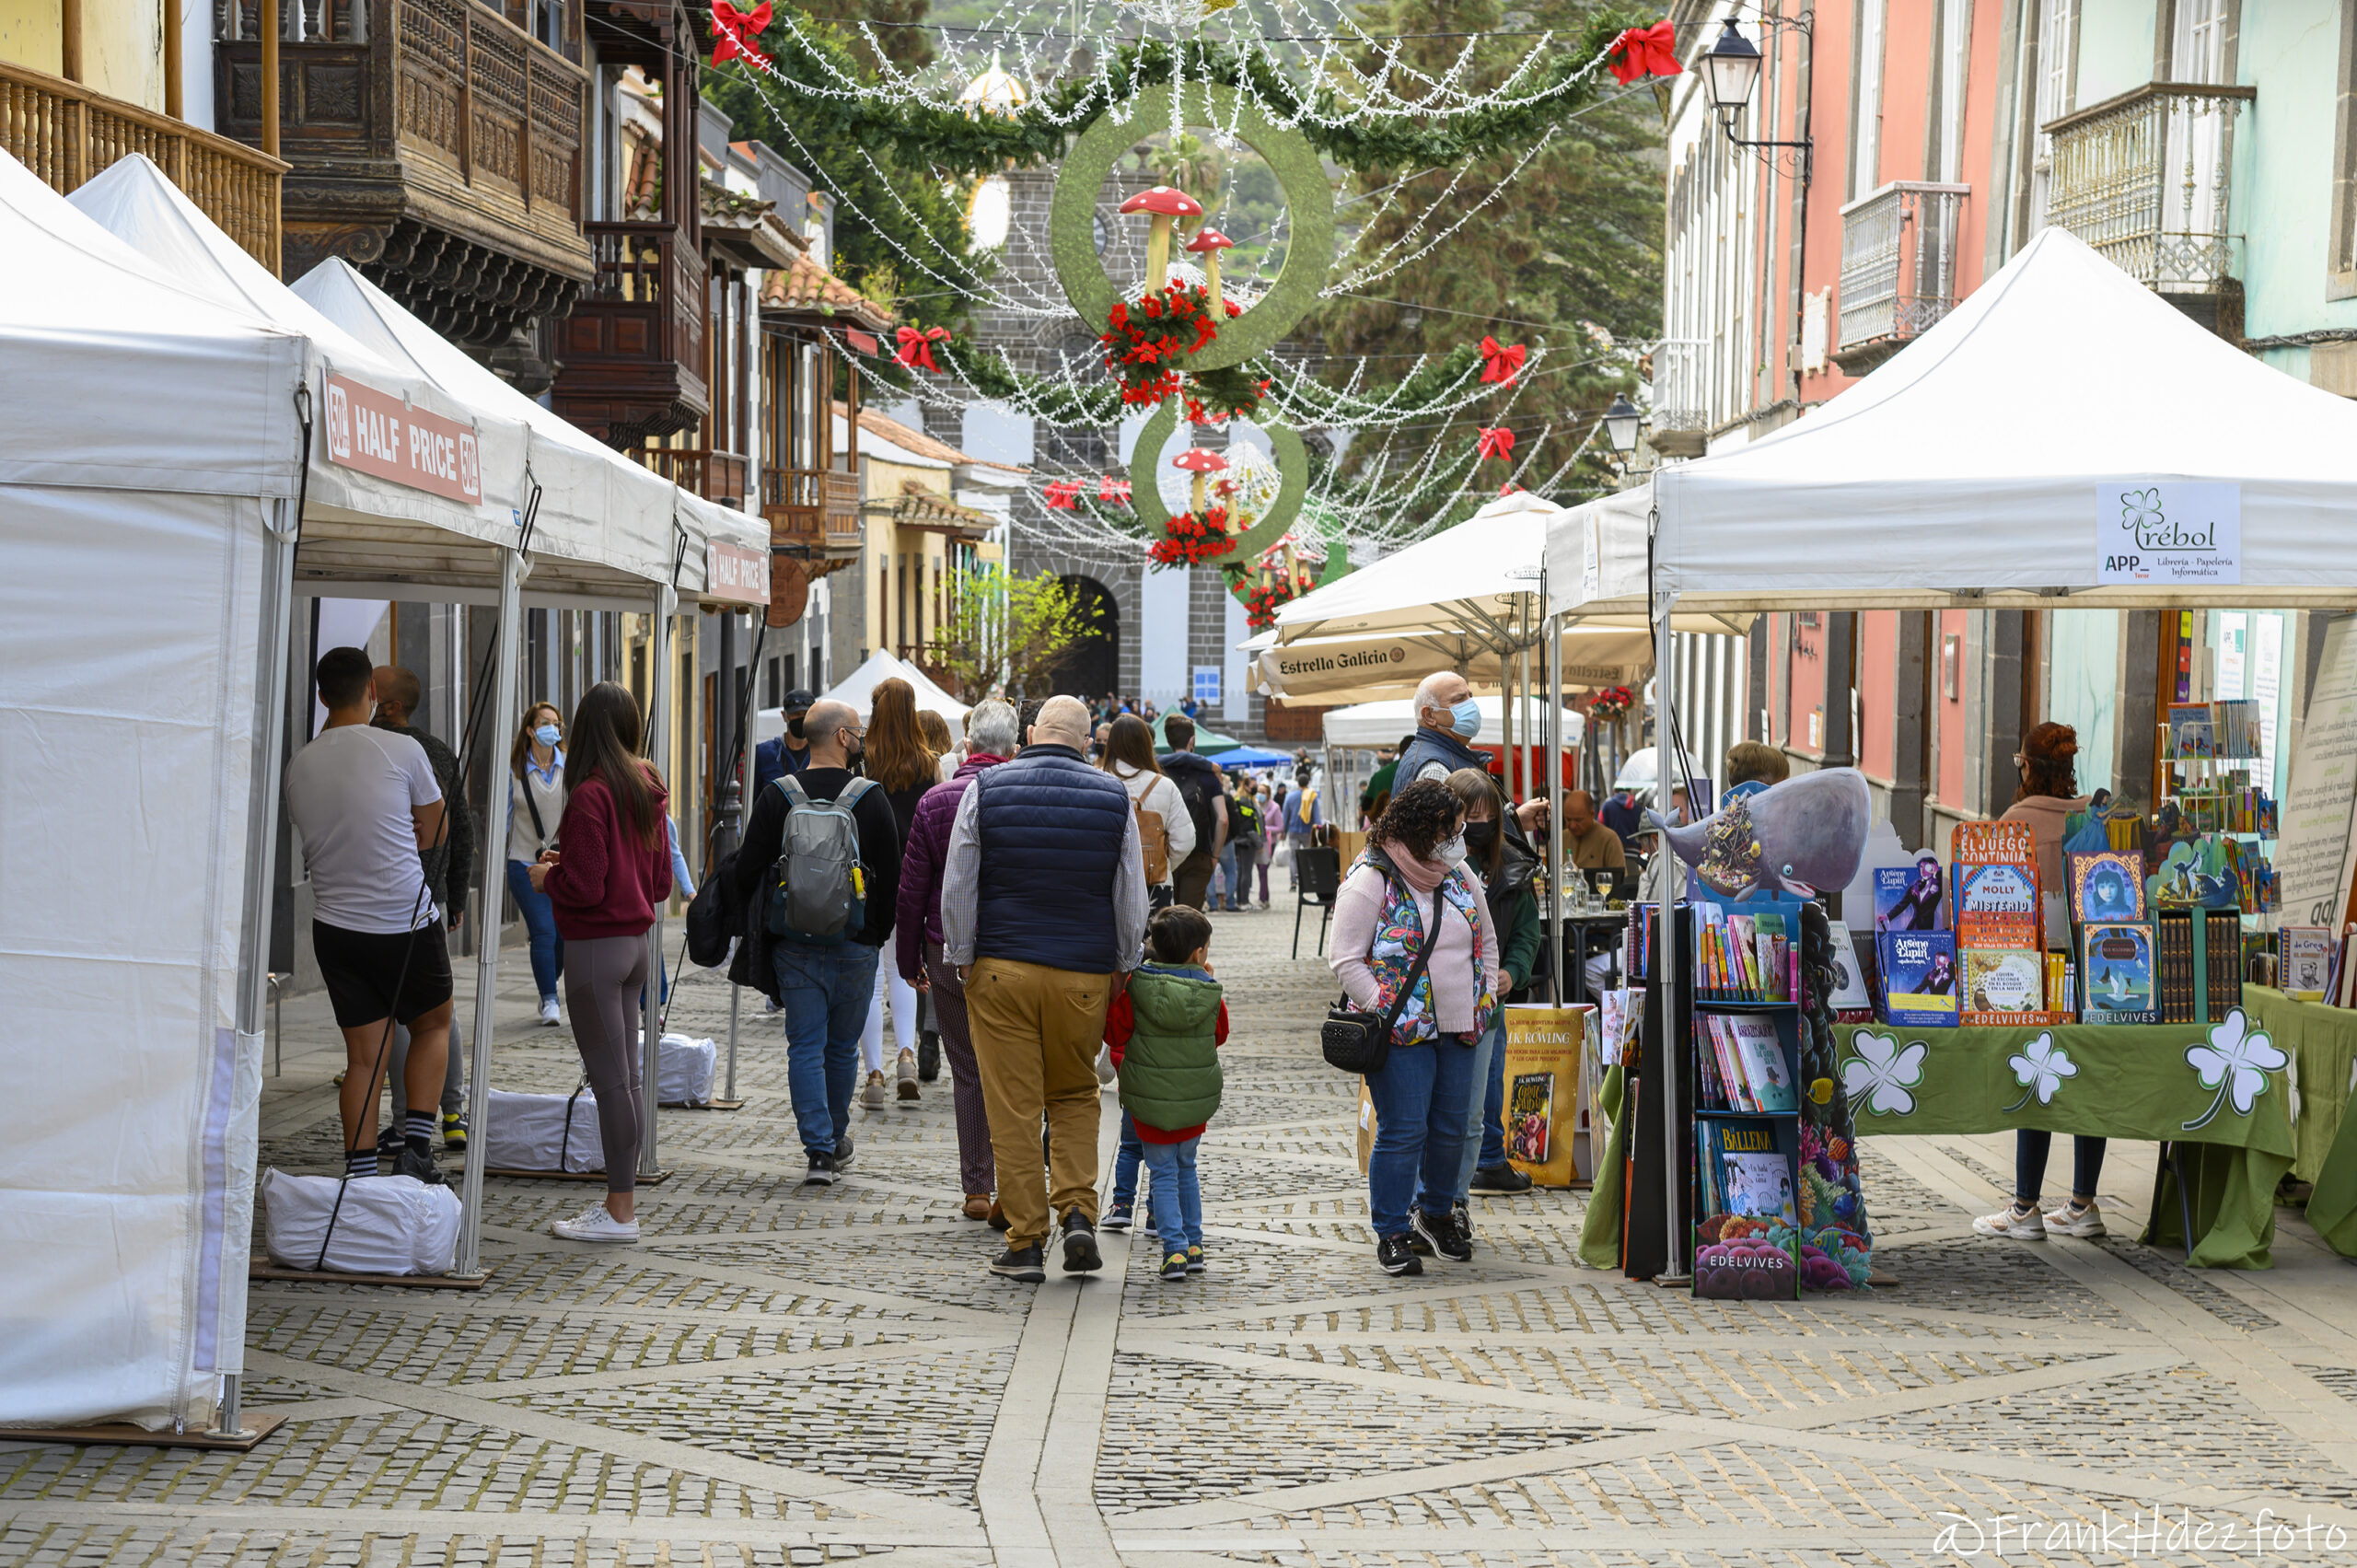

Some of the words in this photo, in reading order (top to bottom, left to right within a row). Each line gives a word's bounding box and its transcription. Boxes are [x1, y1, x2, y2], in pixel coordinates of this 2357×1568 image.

[355, 405, 400, 464] HALF
[409, 424, 457, 481] PRICE
[2157, 557, 2189, 567] Librería
[2196, 557, 2233, 568] Papelería
[719, 554, 737, 586] HALF
[740, 559, 759, 589] PRICE
[2171, 567, 2219, 578] Informática
[1280, 657, 1334, 674] Estrella
[1337, 650, 1387, 668] Galicia
[1961, 839, 1976, 852] EL
[1979, 838, 2026, 852] JUEGO
[1880, 877, 1908, 886] Lupin
[1982, 886, 2014, 894] MOLLY
[1970, 900, 2028, 912] MISTERIO
[1895, 938, 1929, 948] Arsène
[2304, 941, 2324, 952] Greg
[1897, 947, 1931, 959] Lupin
[1975, 1014, 2034, 1025] EDELVIVES
[2090, 1012, 2156, 1023] EDELVIVES
[1525, 1031, 1570, 1044] ROWLING
[1723, 1128, 1772, 1151] BALLENA
[1711, 1255, 1783, 1269] EDELVIVES
